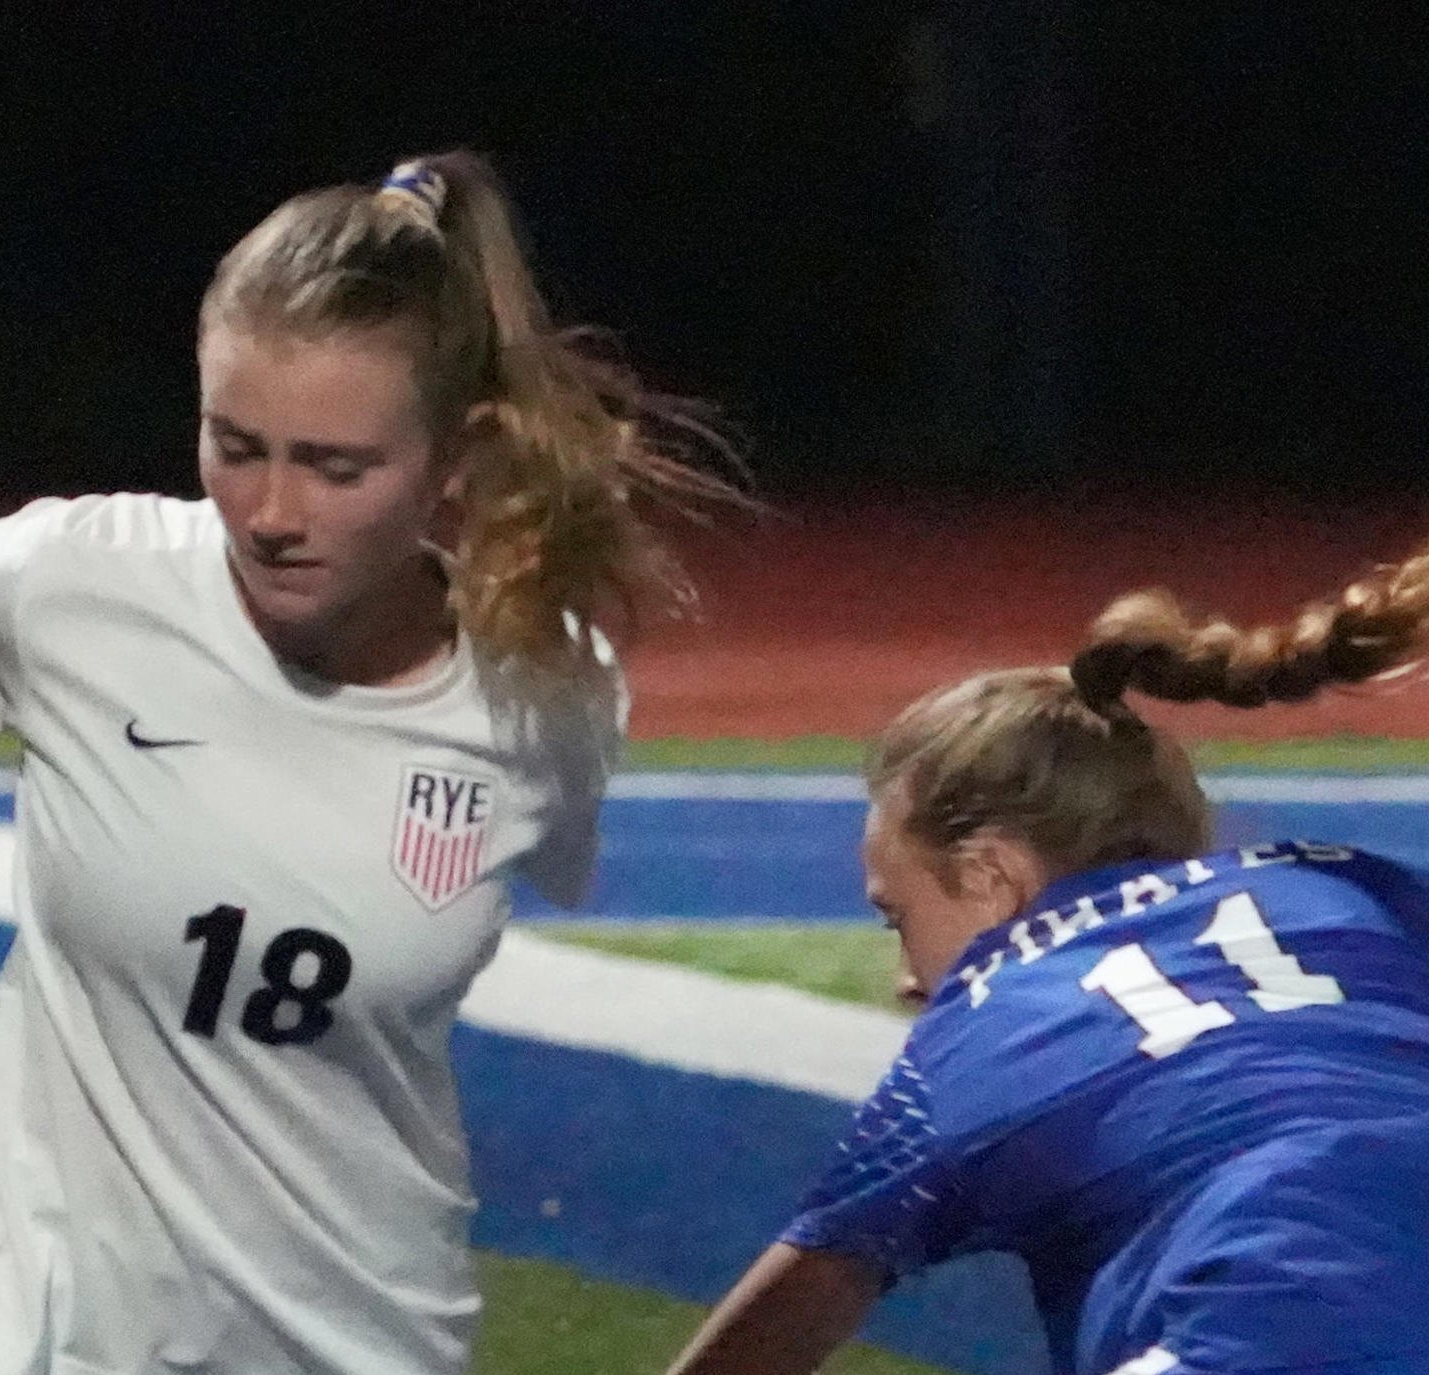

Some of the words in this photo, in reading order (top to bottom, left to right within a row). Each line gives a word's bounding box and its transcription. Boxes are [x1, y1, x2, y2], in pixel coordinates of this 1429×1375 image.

[409, 774, 488, 829] RYE
[182, 903, 352, 1046] 18
[1081, 891, 1346, 1060] 11
